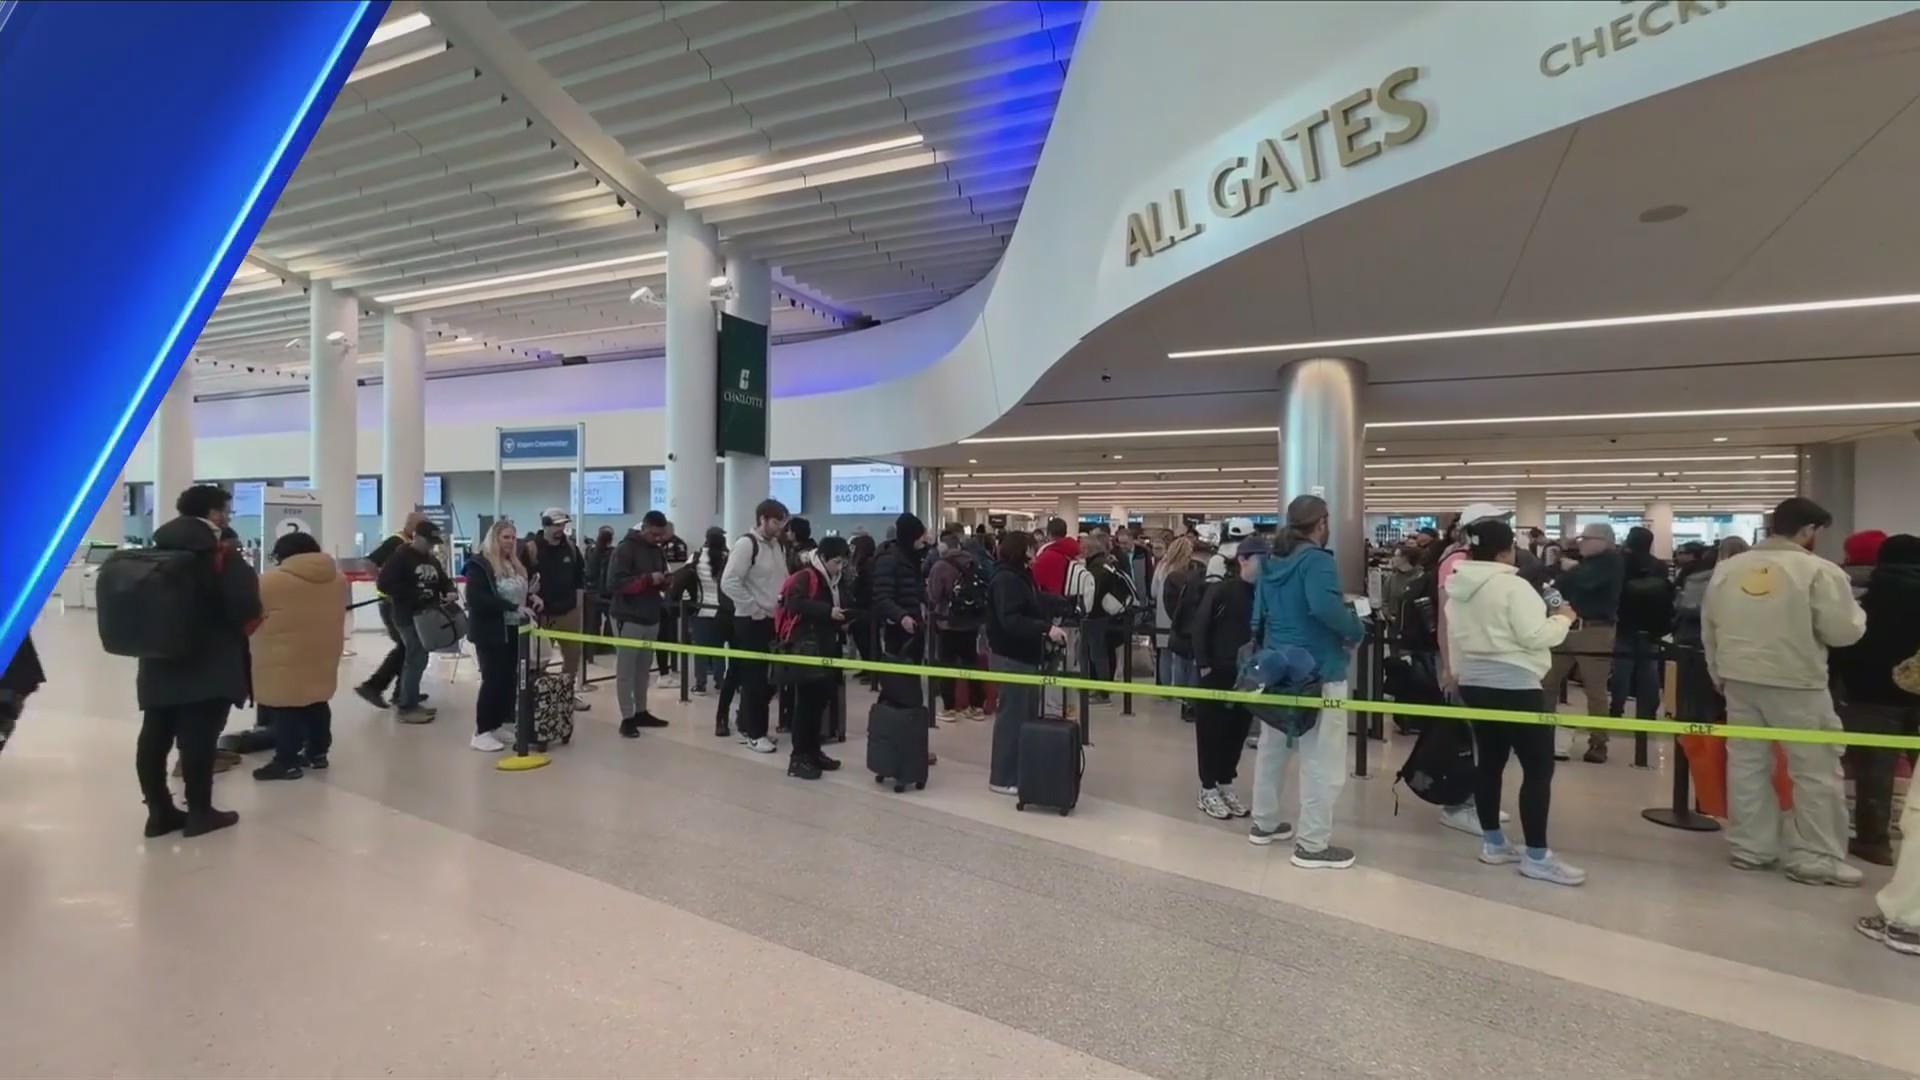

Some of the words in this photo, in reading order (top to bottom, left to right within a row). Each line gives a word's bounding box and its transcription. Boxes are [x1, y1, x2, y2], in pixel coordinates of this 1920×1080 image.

[1540, 0, 1728, 77] CHECK
[1125, 188, 1205, 267] ALL
[1207, 66, 1428, 218] GATES
[835, 484, 871, 493] PRIORITY
[835, 494, 852, 503] BAG
[853, 494, 875, 503] DROP
[1323, 699, 1341, 709] CLT
[1689, 723, 1713, 734] CLT
